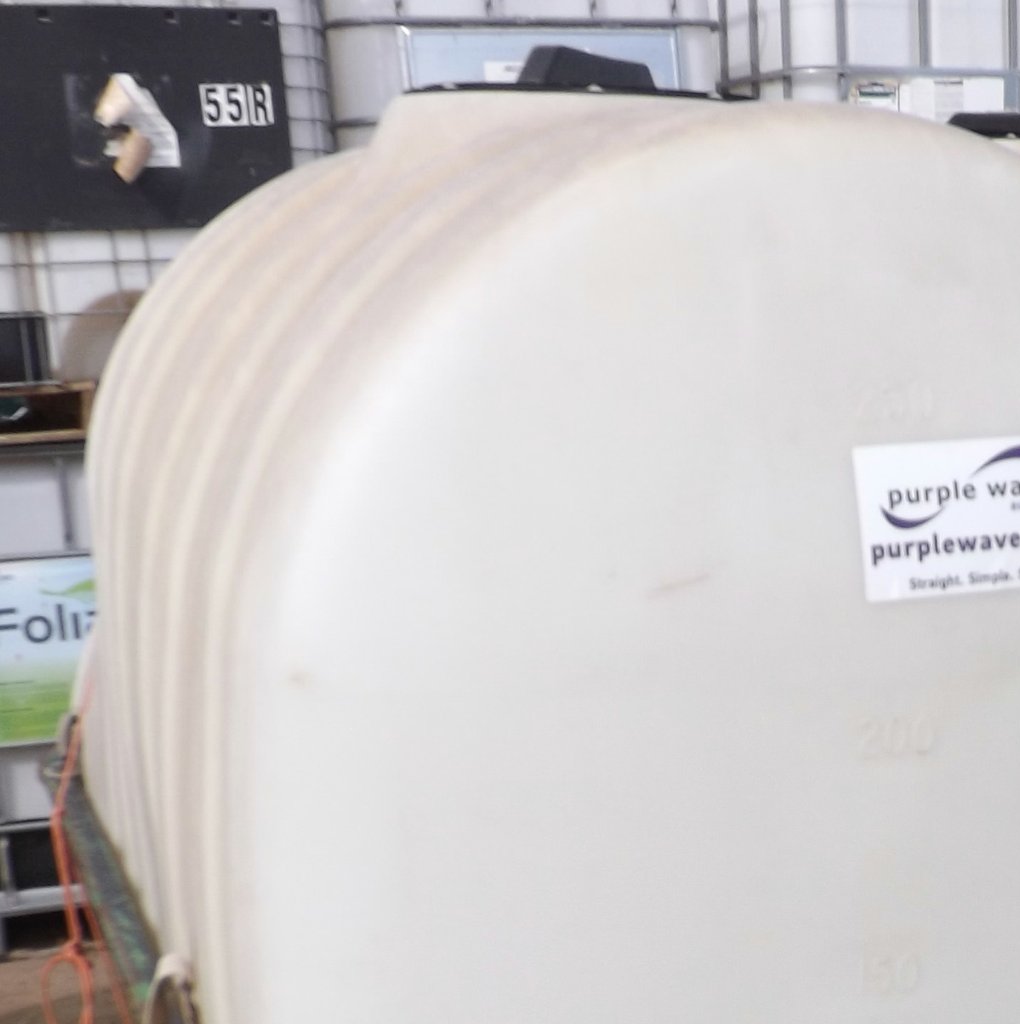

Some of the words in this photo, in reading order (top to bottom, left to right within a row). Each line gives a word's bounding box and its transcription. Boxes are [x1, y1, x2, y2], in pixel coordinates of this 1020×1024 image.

[887, 479, 977, 509] purple
[909, 573, 963, 592] Straight.
[968, 568, 1013, 585] Simple.
